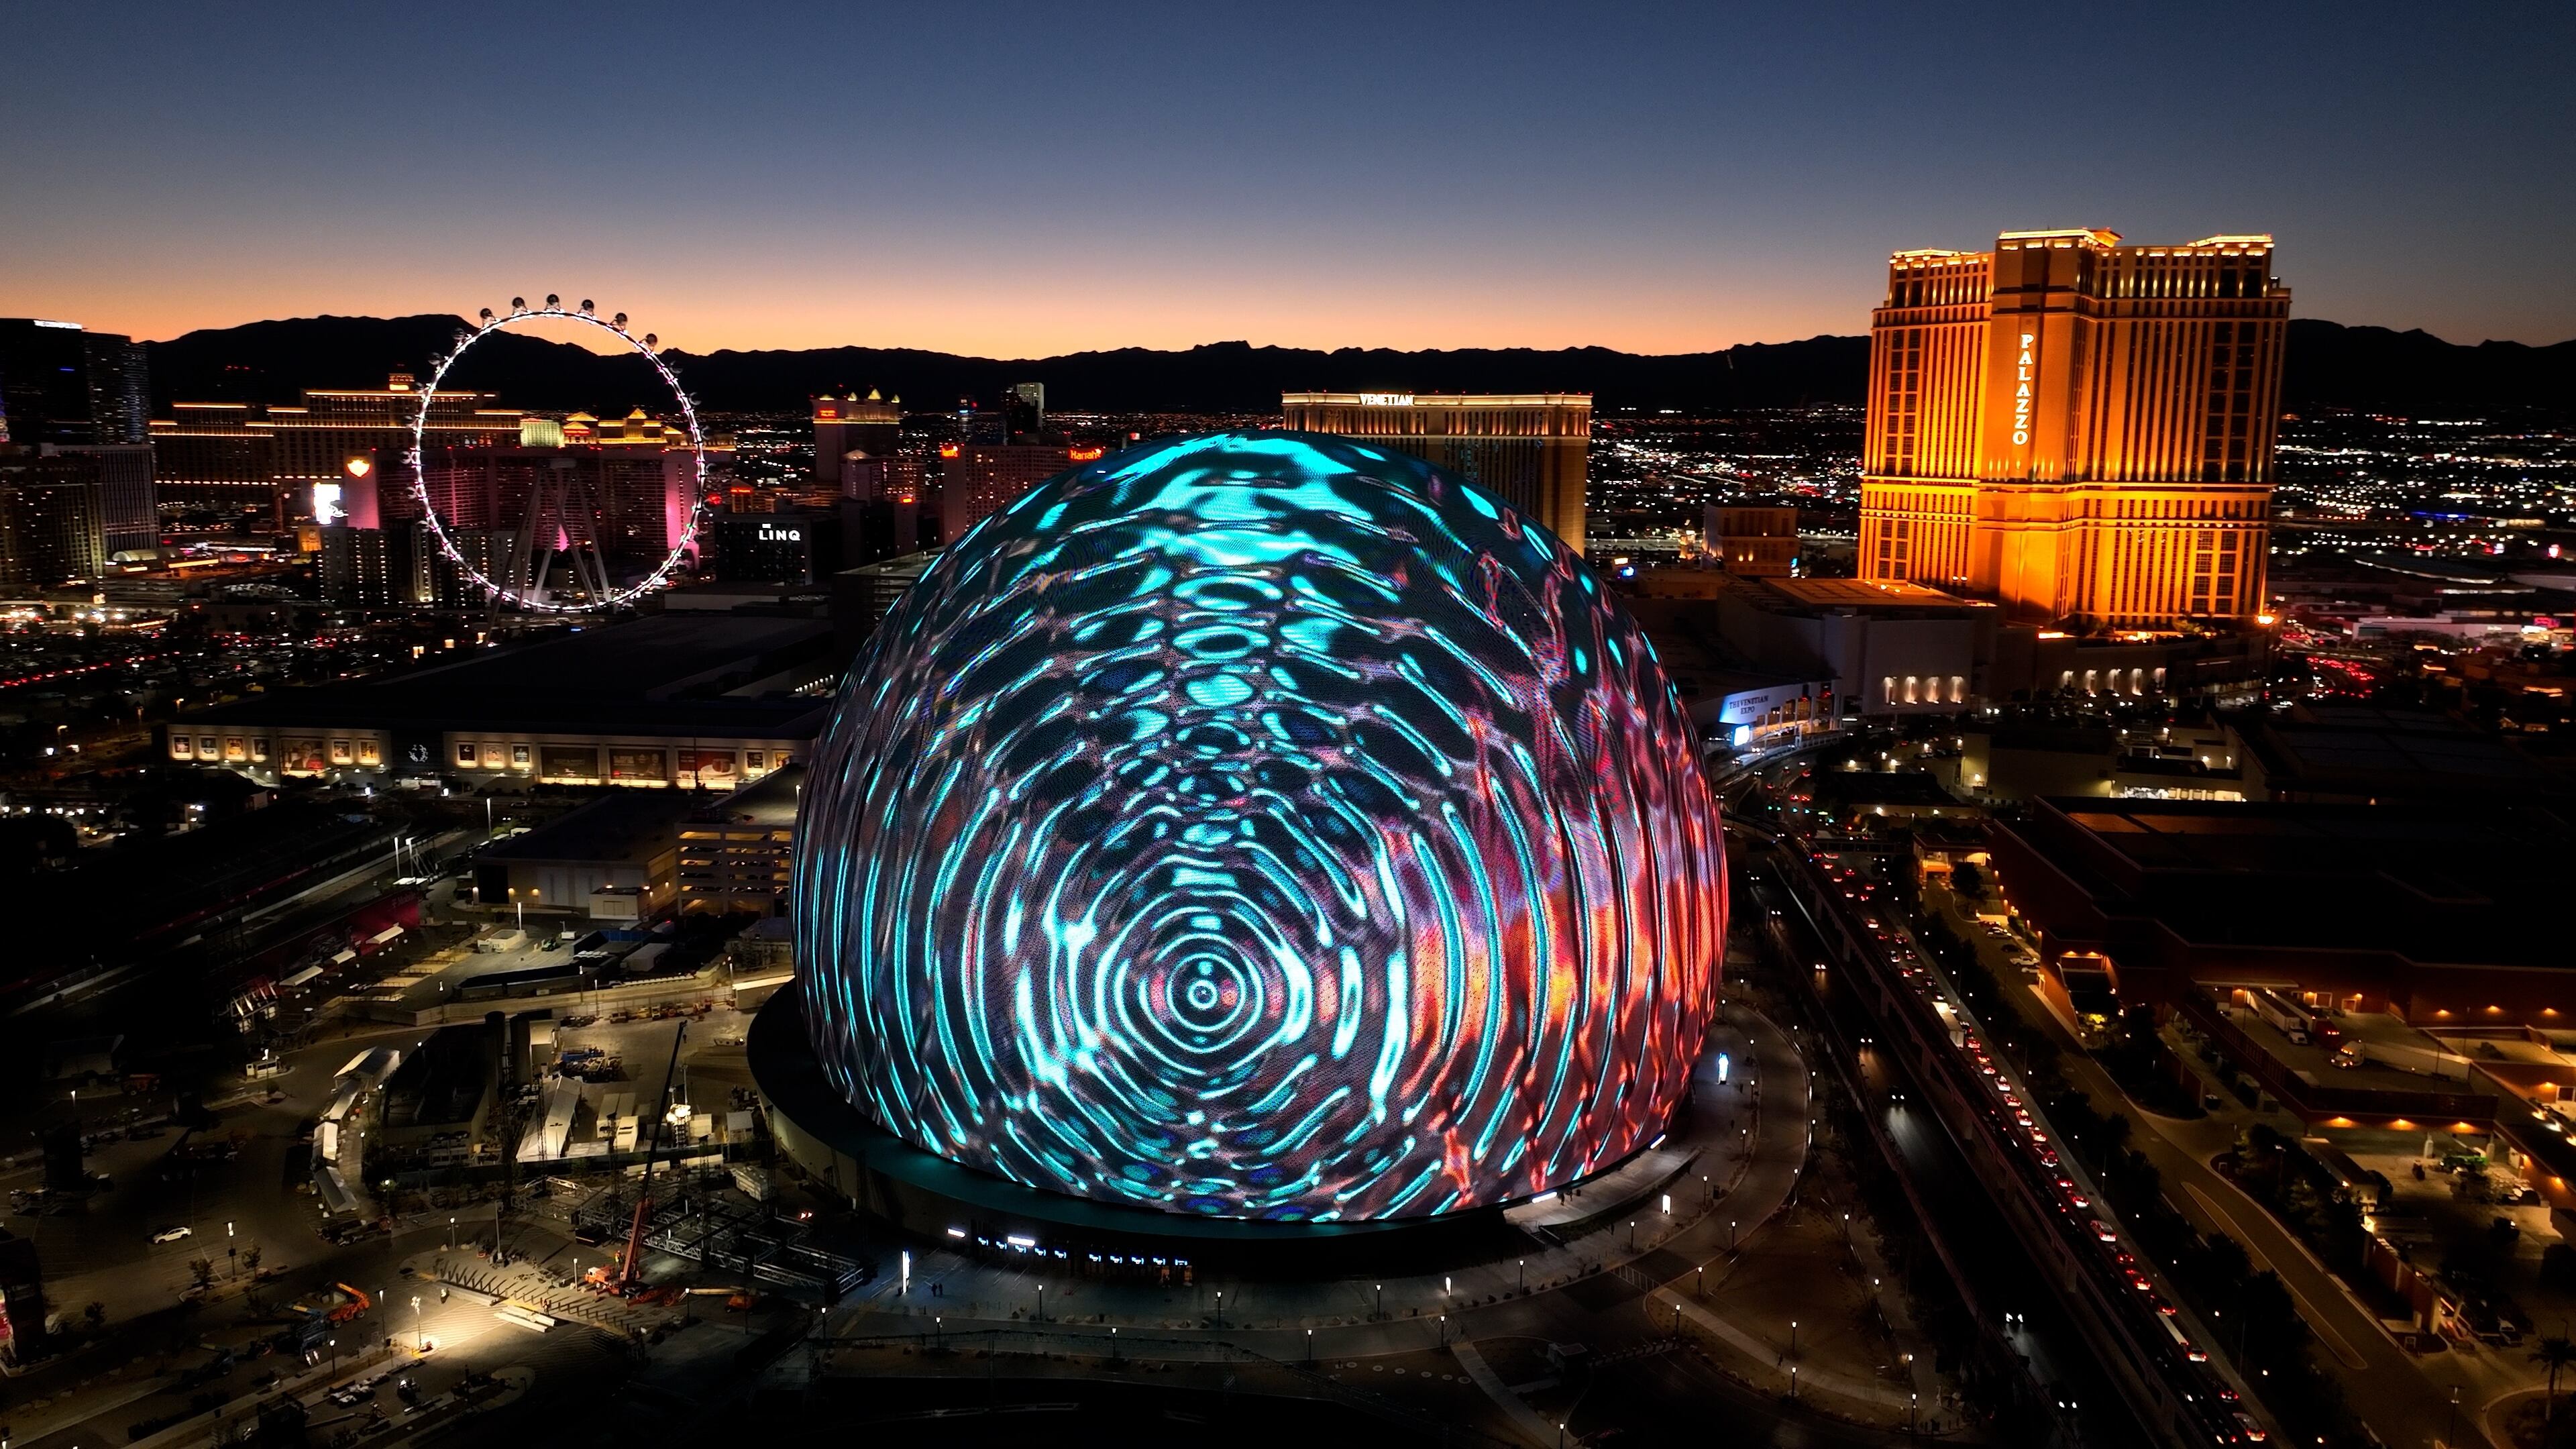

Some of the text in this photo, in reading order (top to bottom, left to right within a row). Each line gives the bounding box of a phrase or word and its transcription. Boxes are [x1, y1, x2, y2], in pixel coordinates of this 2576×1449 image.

[2012, 333, 2035, 445] PALAZZO
[1360, 393, 1415, 405] VENETIAN
[759, 530, 800, 541] LINQ
[1740, 695, 1768, 706] VENETIAN
[1741, 706, 1755, 714] EXPO
